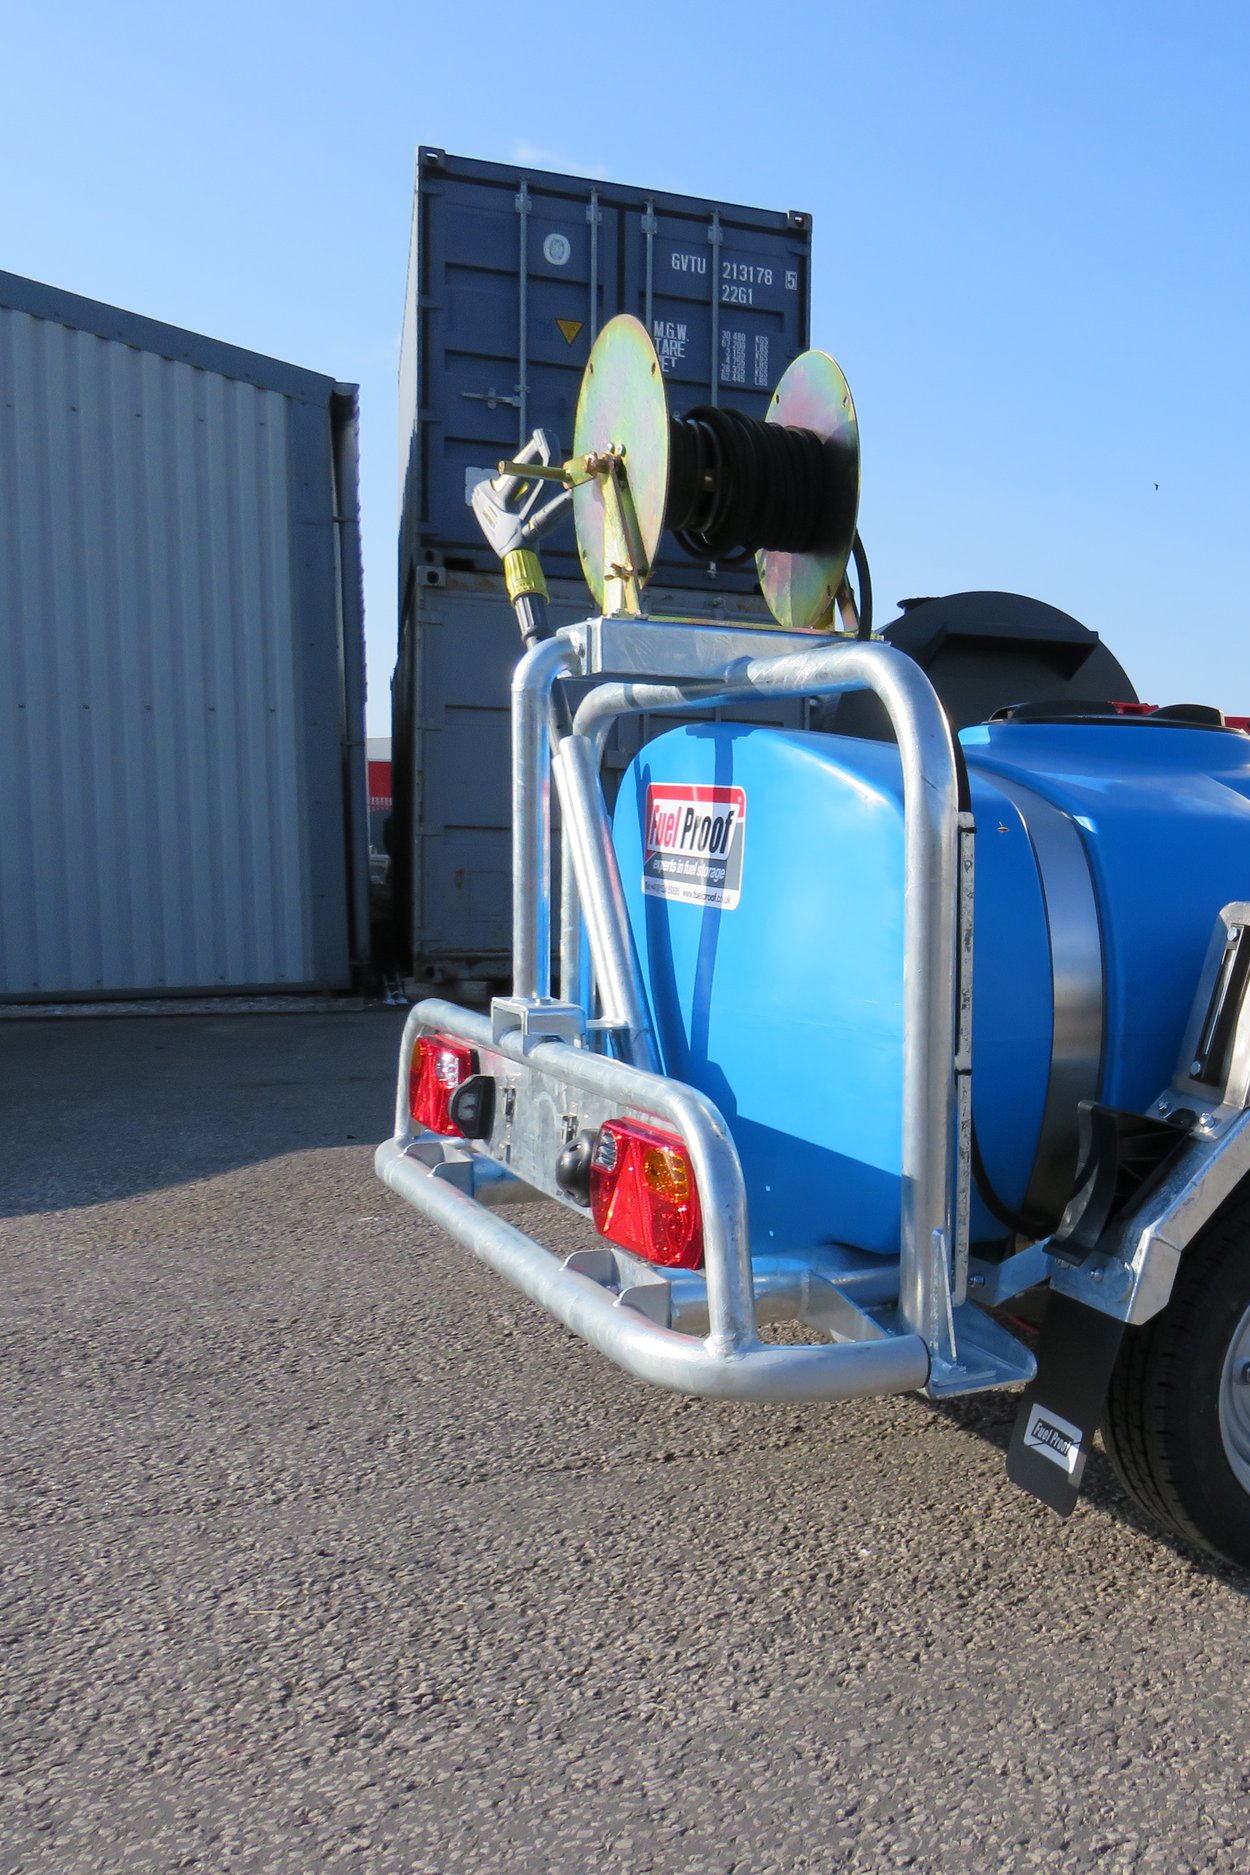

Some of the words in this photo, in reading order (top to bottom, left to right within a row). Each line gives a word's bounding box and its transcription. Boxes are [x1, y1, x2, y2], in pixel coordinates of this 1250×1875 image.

[671, 253, 706, 274] GVTU
[722, 262, 773, 285] 213178
[786, 272, 797, 290] 5
[721, 285, 753, 304] 22G1
[654, 320, 689, 342] M.G.W.
[654, 337, 686, 358] TARE
[659, 356, 678, 373] ET
[650, 805, 682, 848] Fuel
[680, 807, 735, 854] Proof
[696, 863, 725, 882] storage
[1033, 1422, 1053, 1442] Fuel
[1050, 1431, 1073, 1454] Proof
